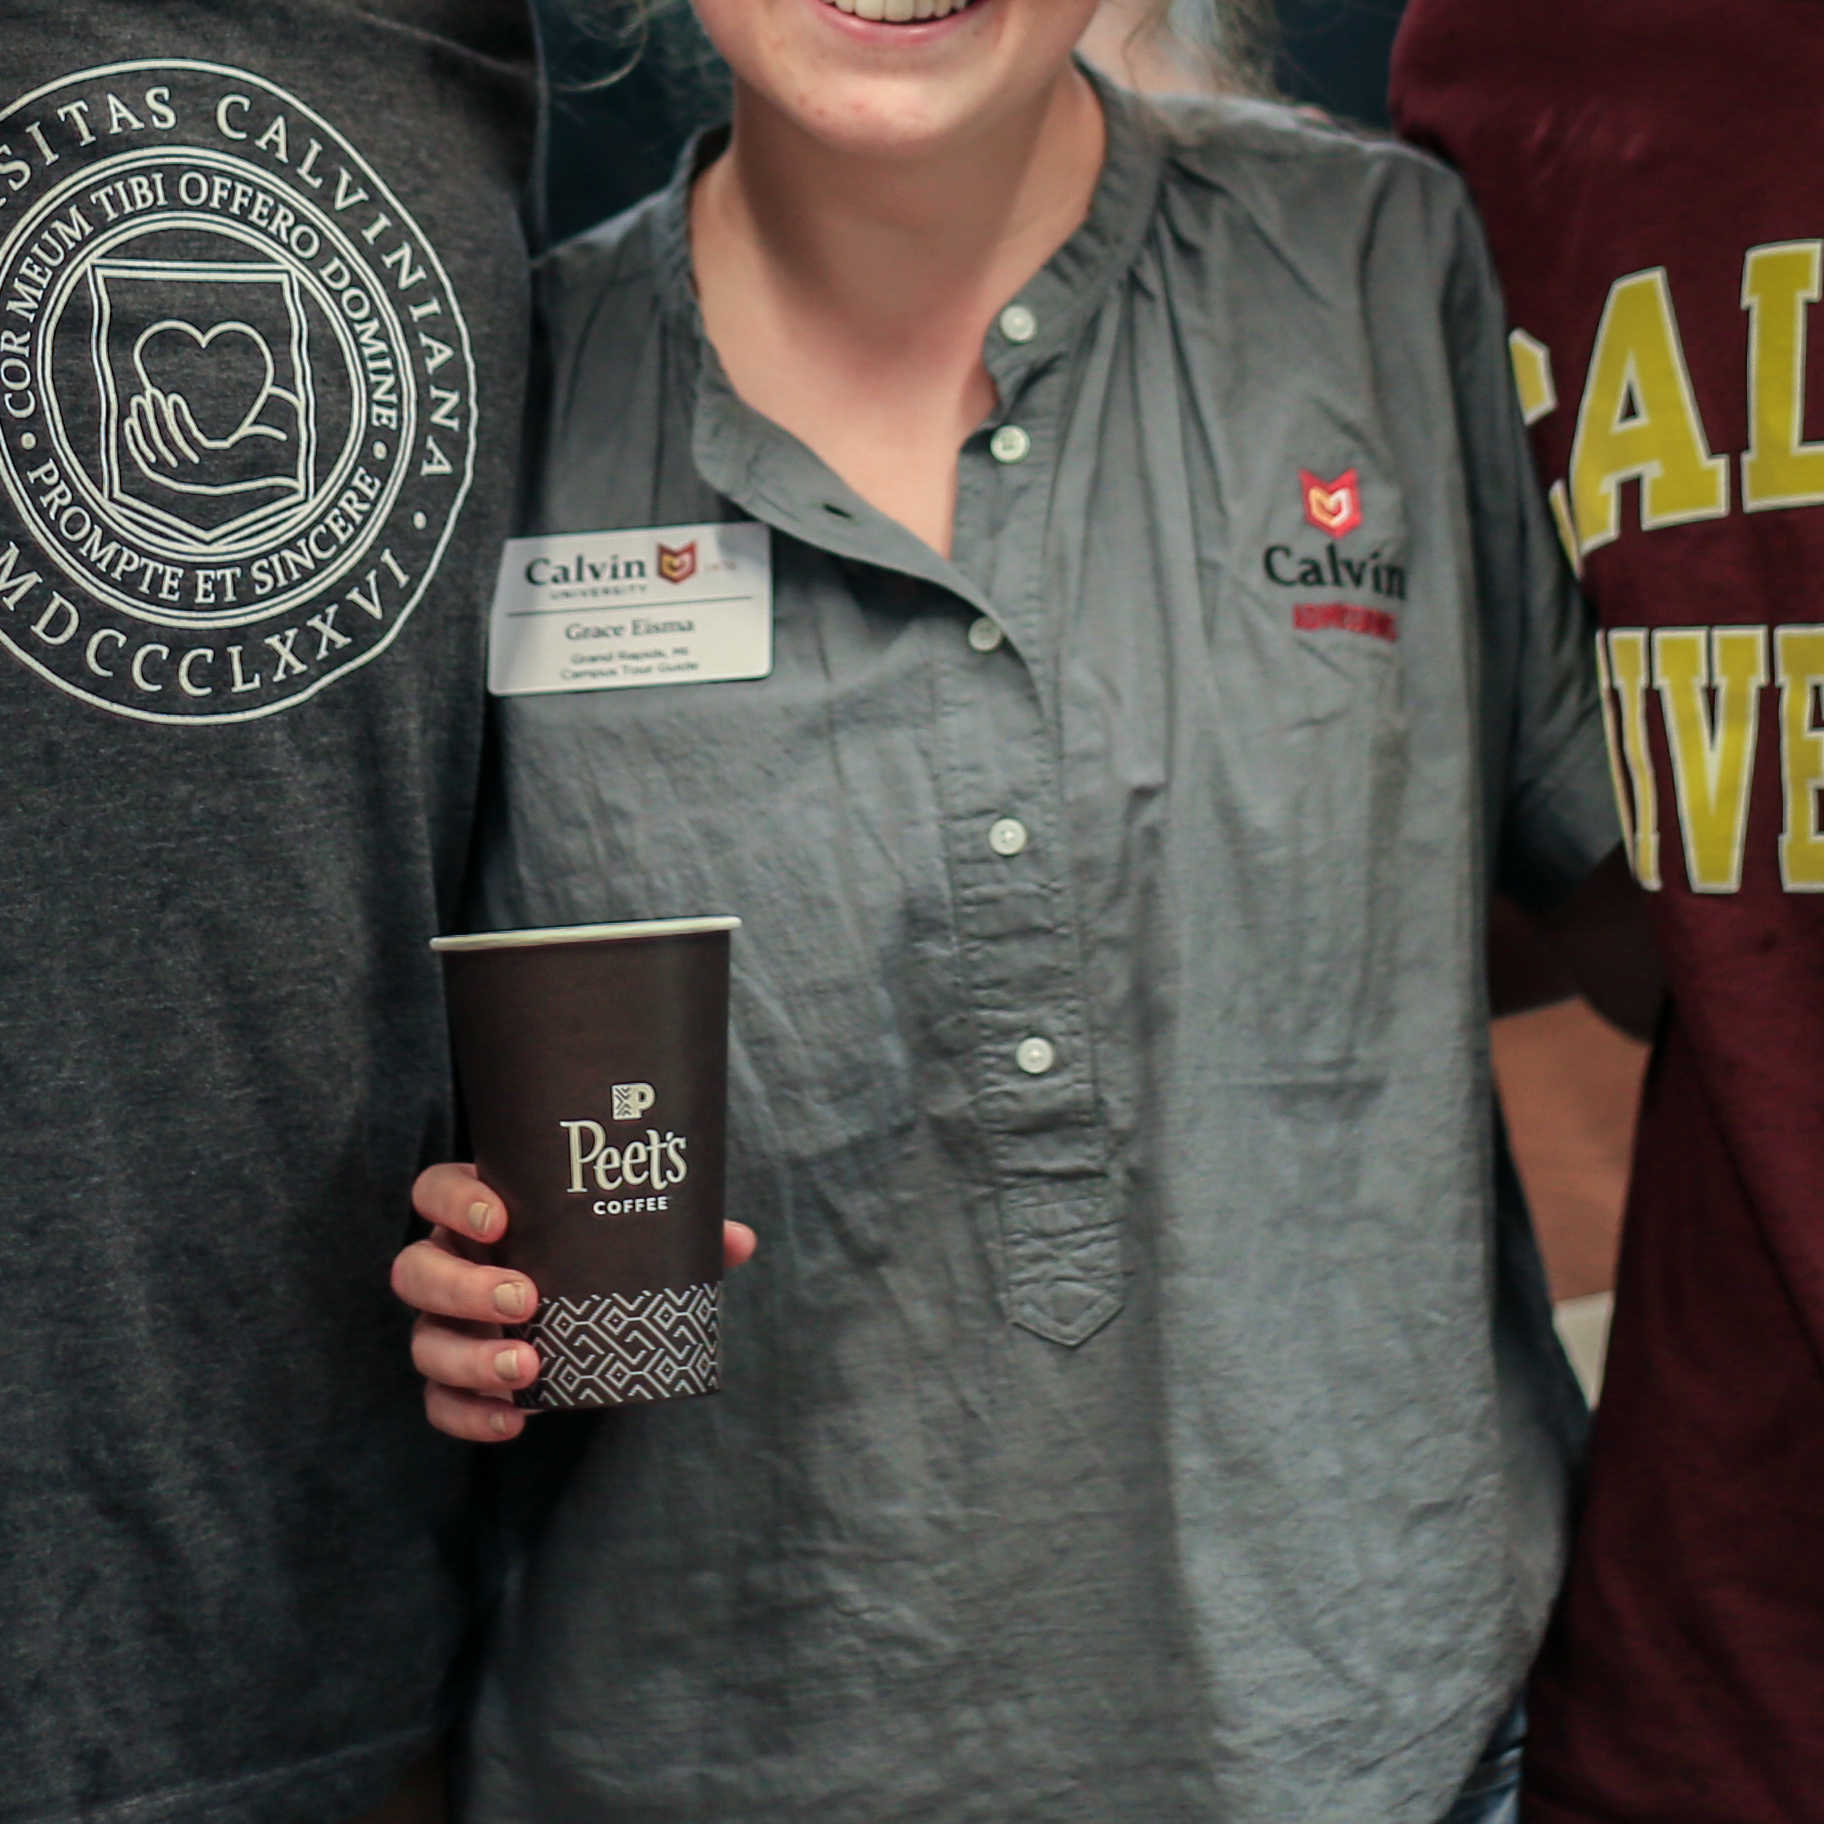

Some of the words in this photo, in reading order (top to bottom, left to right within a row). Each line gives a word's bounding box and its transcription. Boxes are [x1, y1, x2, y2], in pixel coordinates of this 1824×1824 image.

[6, 207, 94, 323] MEUM
[91, 172, 167, 223] TIBI
[178, 170, 322, 260] OFFERO
[319, 257, 397, 431] DOMINE
[217, 94, 460, 477] CALVINIANA
[27, 458, 182, 601] PROMPTE
[194, 564, 241, 604] ET
[251, 473, 382, 596] SINCERE
[525, 553, 647, 585] Calvin
[549, 583, 648, 600] UNIVERSITY
[1264, 542, 1407, 600] Calvin
[565, 624, 624, 642] Grace
[559, 1119, 688, 1193] Peet's
[593, 1195, 669, 1216] COFFEE
